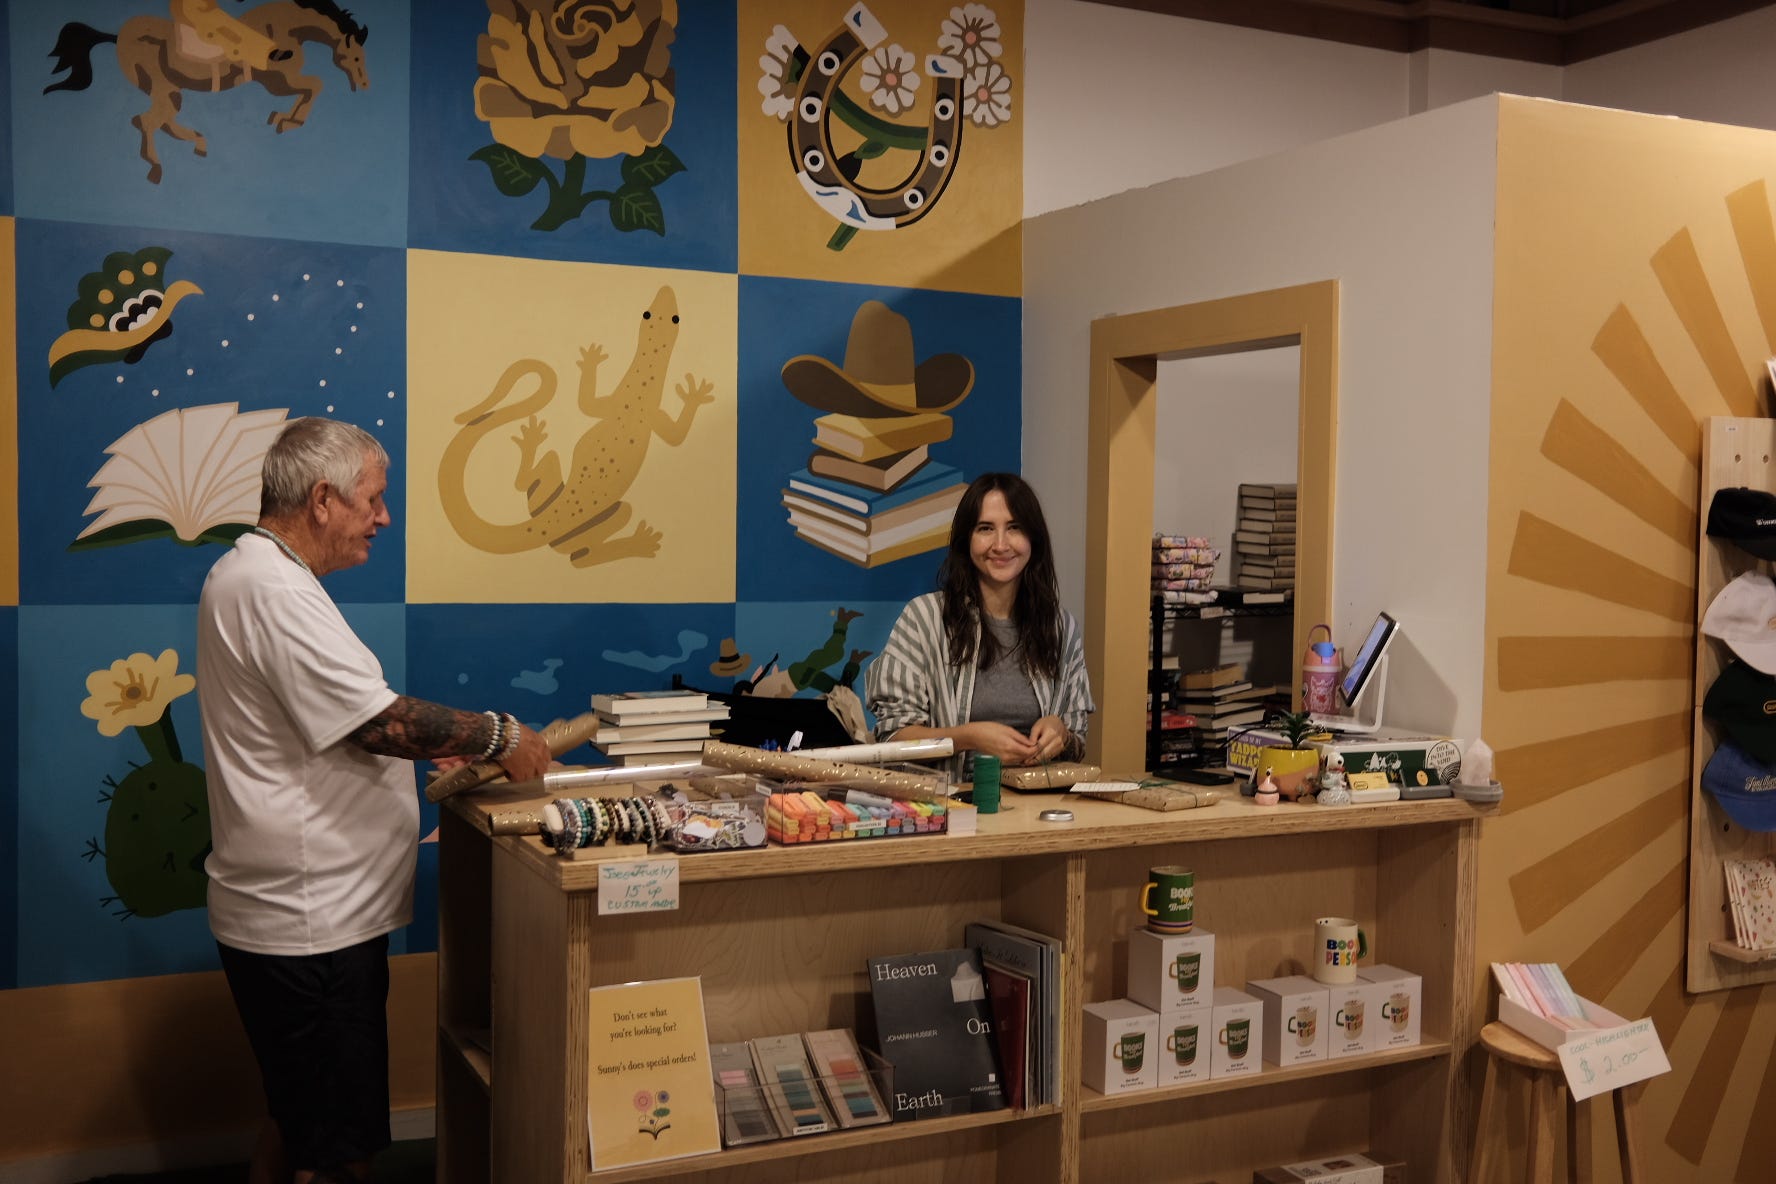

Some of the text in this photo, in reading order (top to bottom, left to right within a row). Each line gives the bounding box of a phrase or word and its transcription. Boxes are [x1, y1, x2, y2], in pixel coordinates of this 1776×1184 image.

[875, 962, 938, 982] Heaven
[613, 1007, 668, 1023] Don't see what
[609, 1022, 678, 1042] you're looking for?
[967, 1017, 991, 1035] On
[597, 1052, 697, 1075] Sunny's does special orders!
[895, 1089, 944, 1112] Earth
